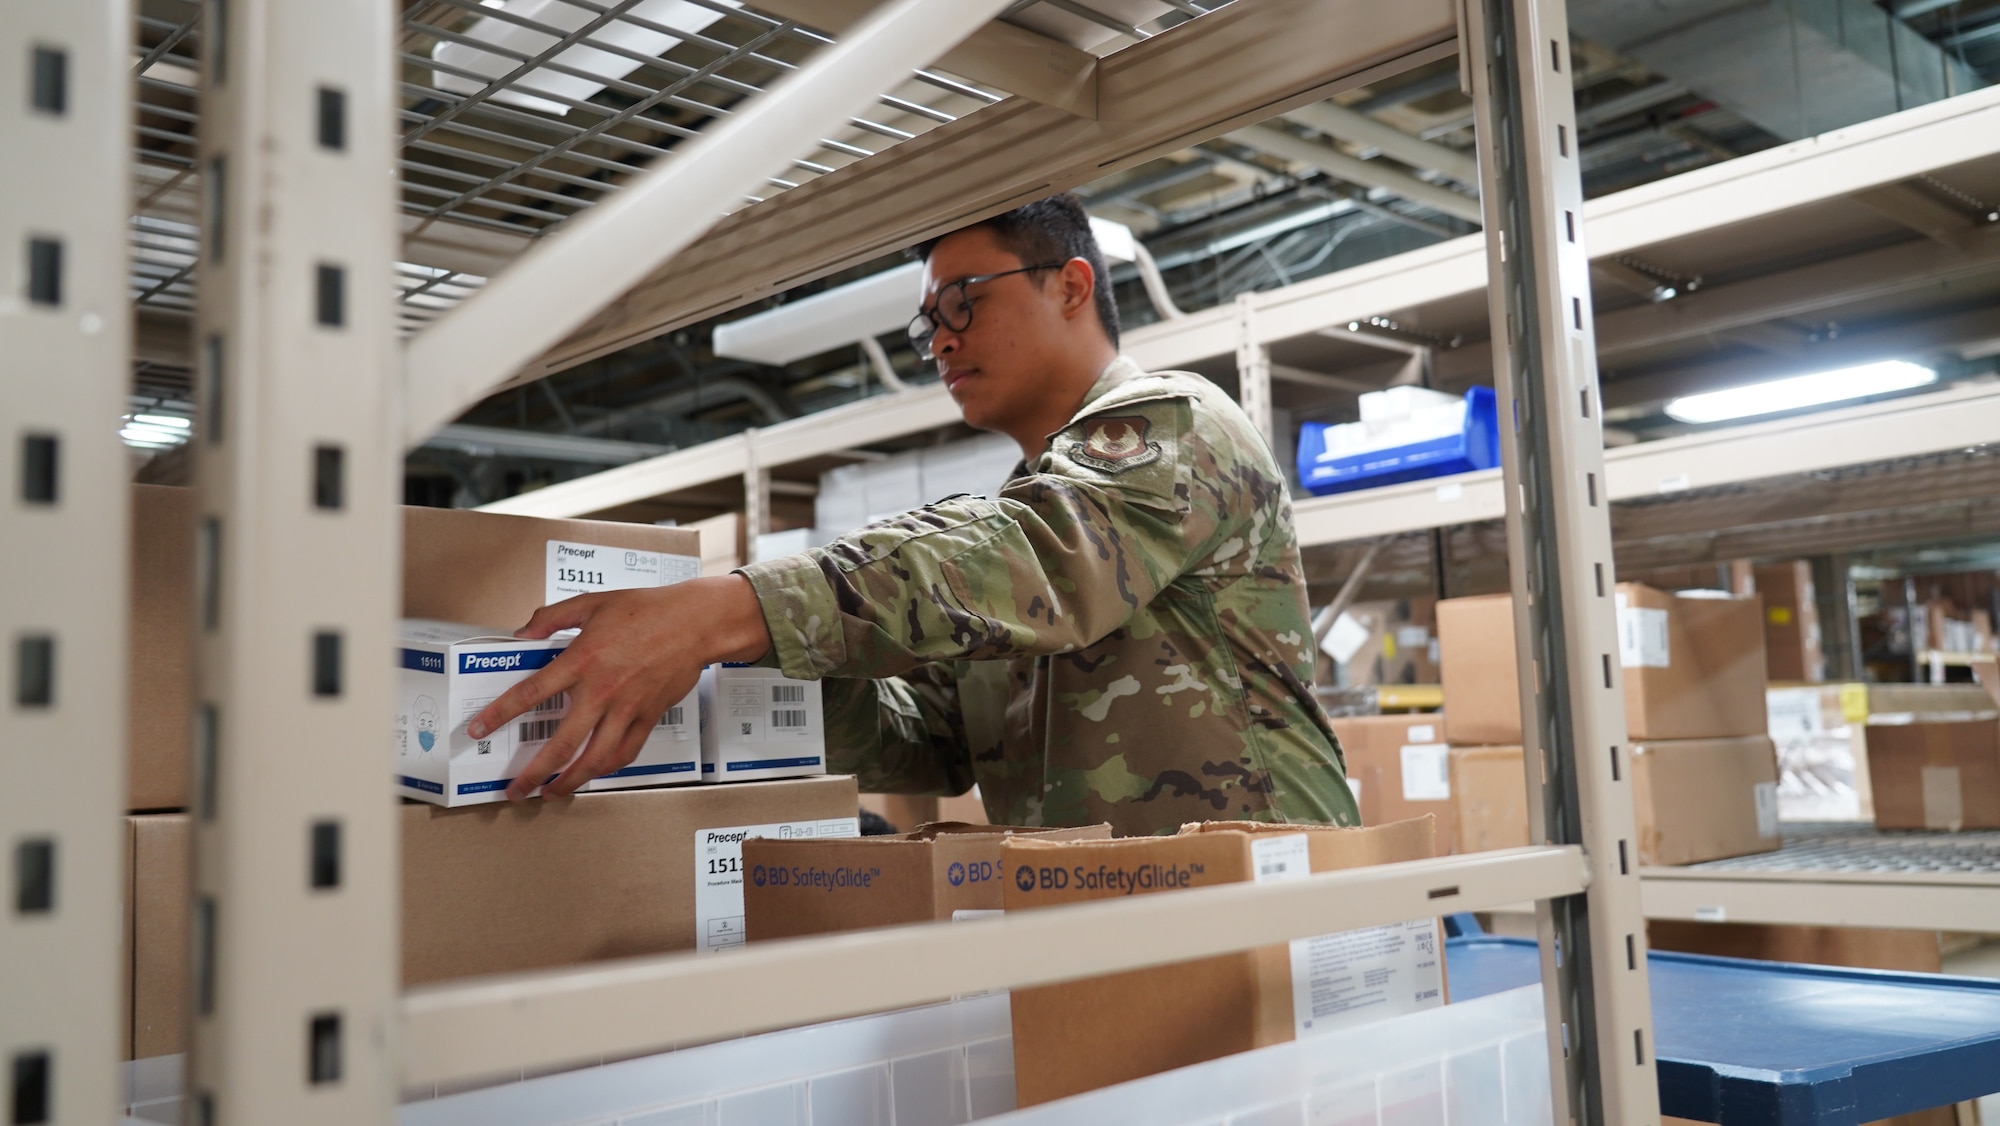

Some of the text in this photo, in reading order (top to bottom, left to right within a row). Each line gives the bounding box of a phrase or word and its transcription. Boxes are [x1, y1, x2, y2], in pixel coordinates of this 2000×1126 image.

[557, 545, 595, 559] Precept
[558, 568, 604, 585] 15111
[420, 656, 441, 668] 15111
[465, 653, 521, 670] Precept
[769, 867, 789, 886] BD
[969, 861, 992, 883] BD
[1040, 867, 1068, 889] BD
